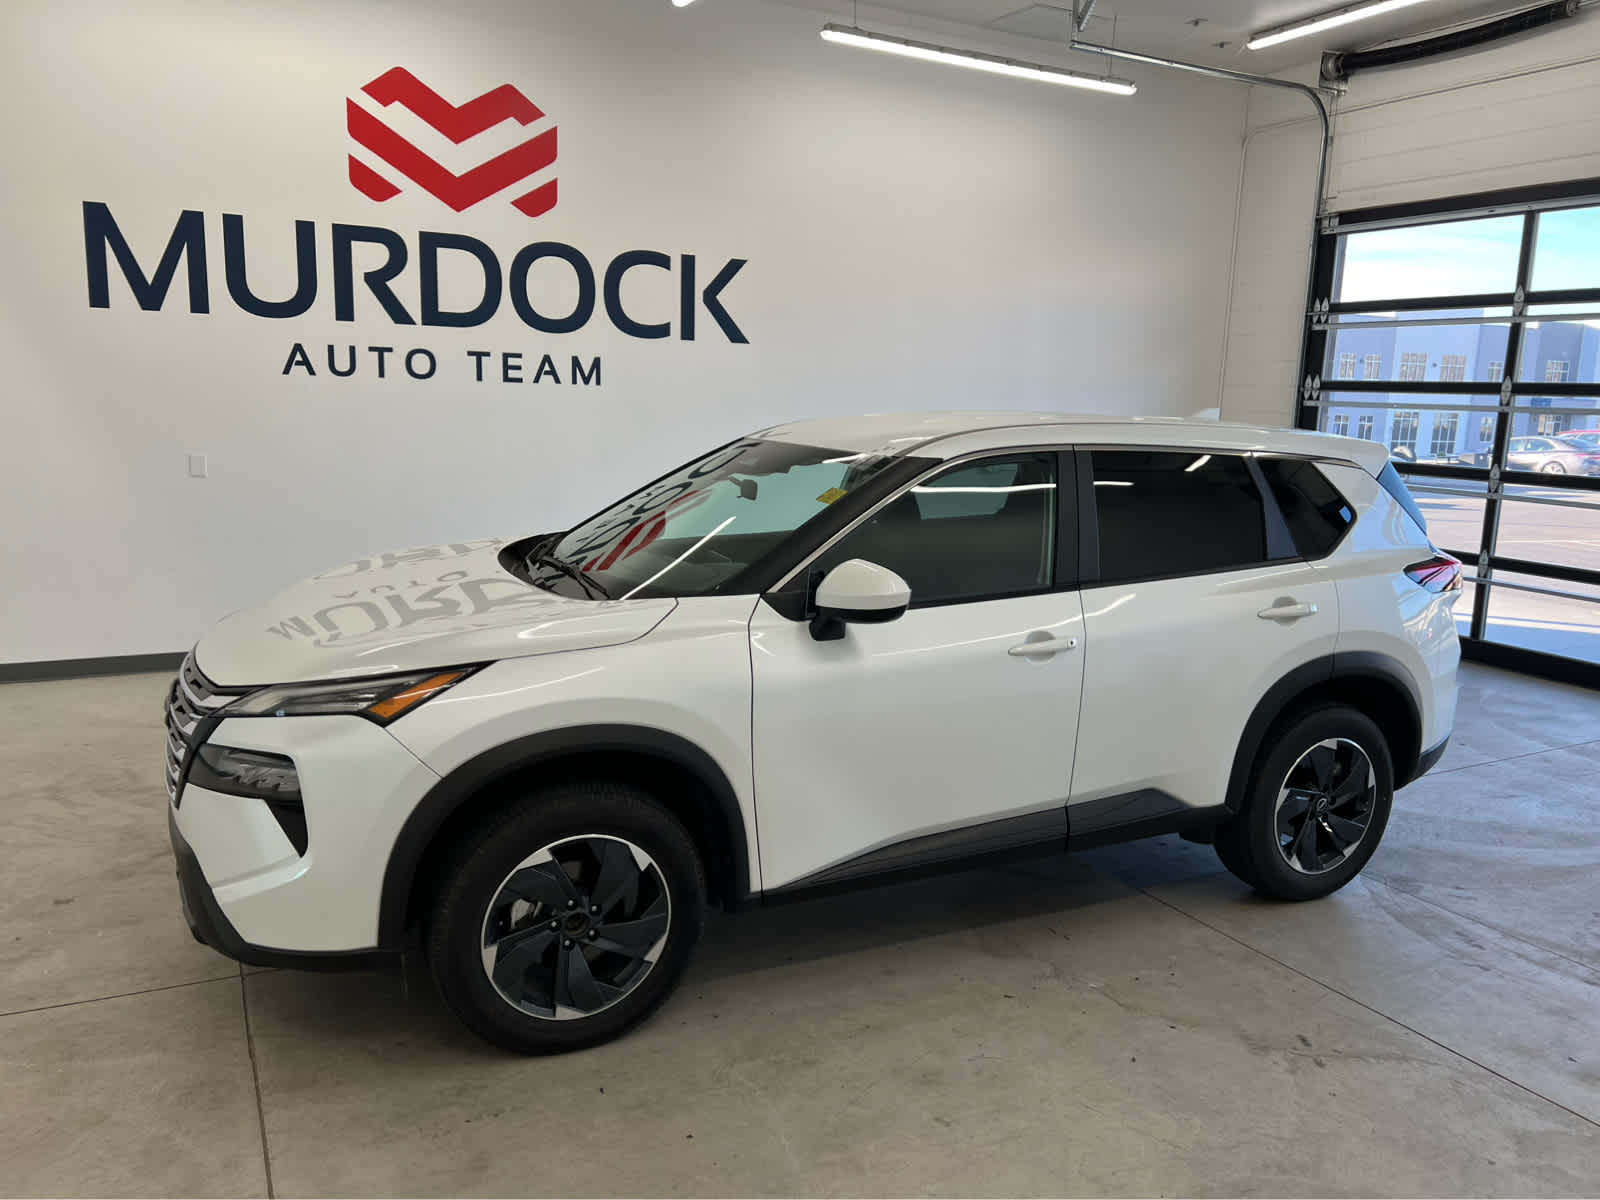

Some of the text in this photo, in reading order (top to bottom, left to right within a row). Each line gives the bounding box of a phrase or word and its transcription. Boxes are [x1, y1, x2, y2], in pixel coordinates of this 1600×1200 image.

[83, 200, 750, 345] MURDOCK
[282, 342, 602, 386] AUTO TEAM
